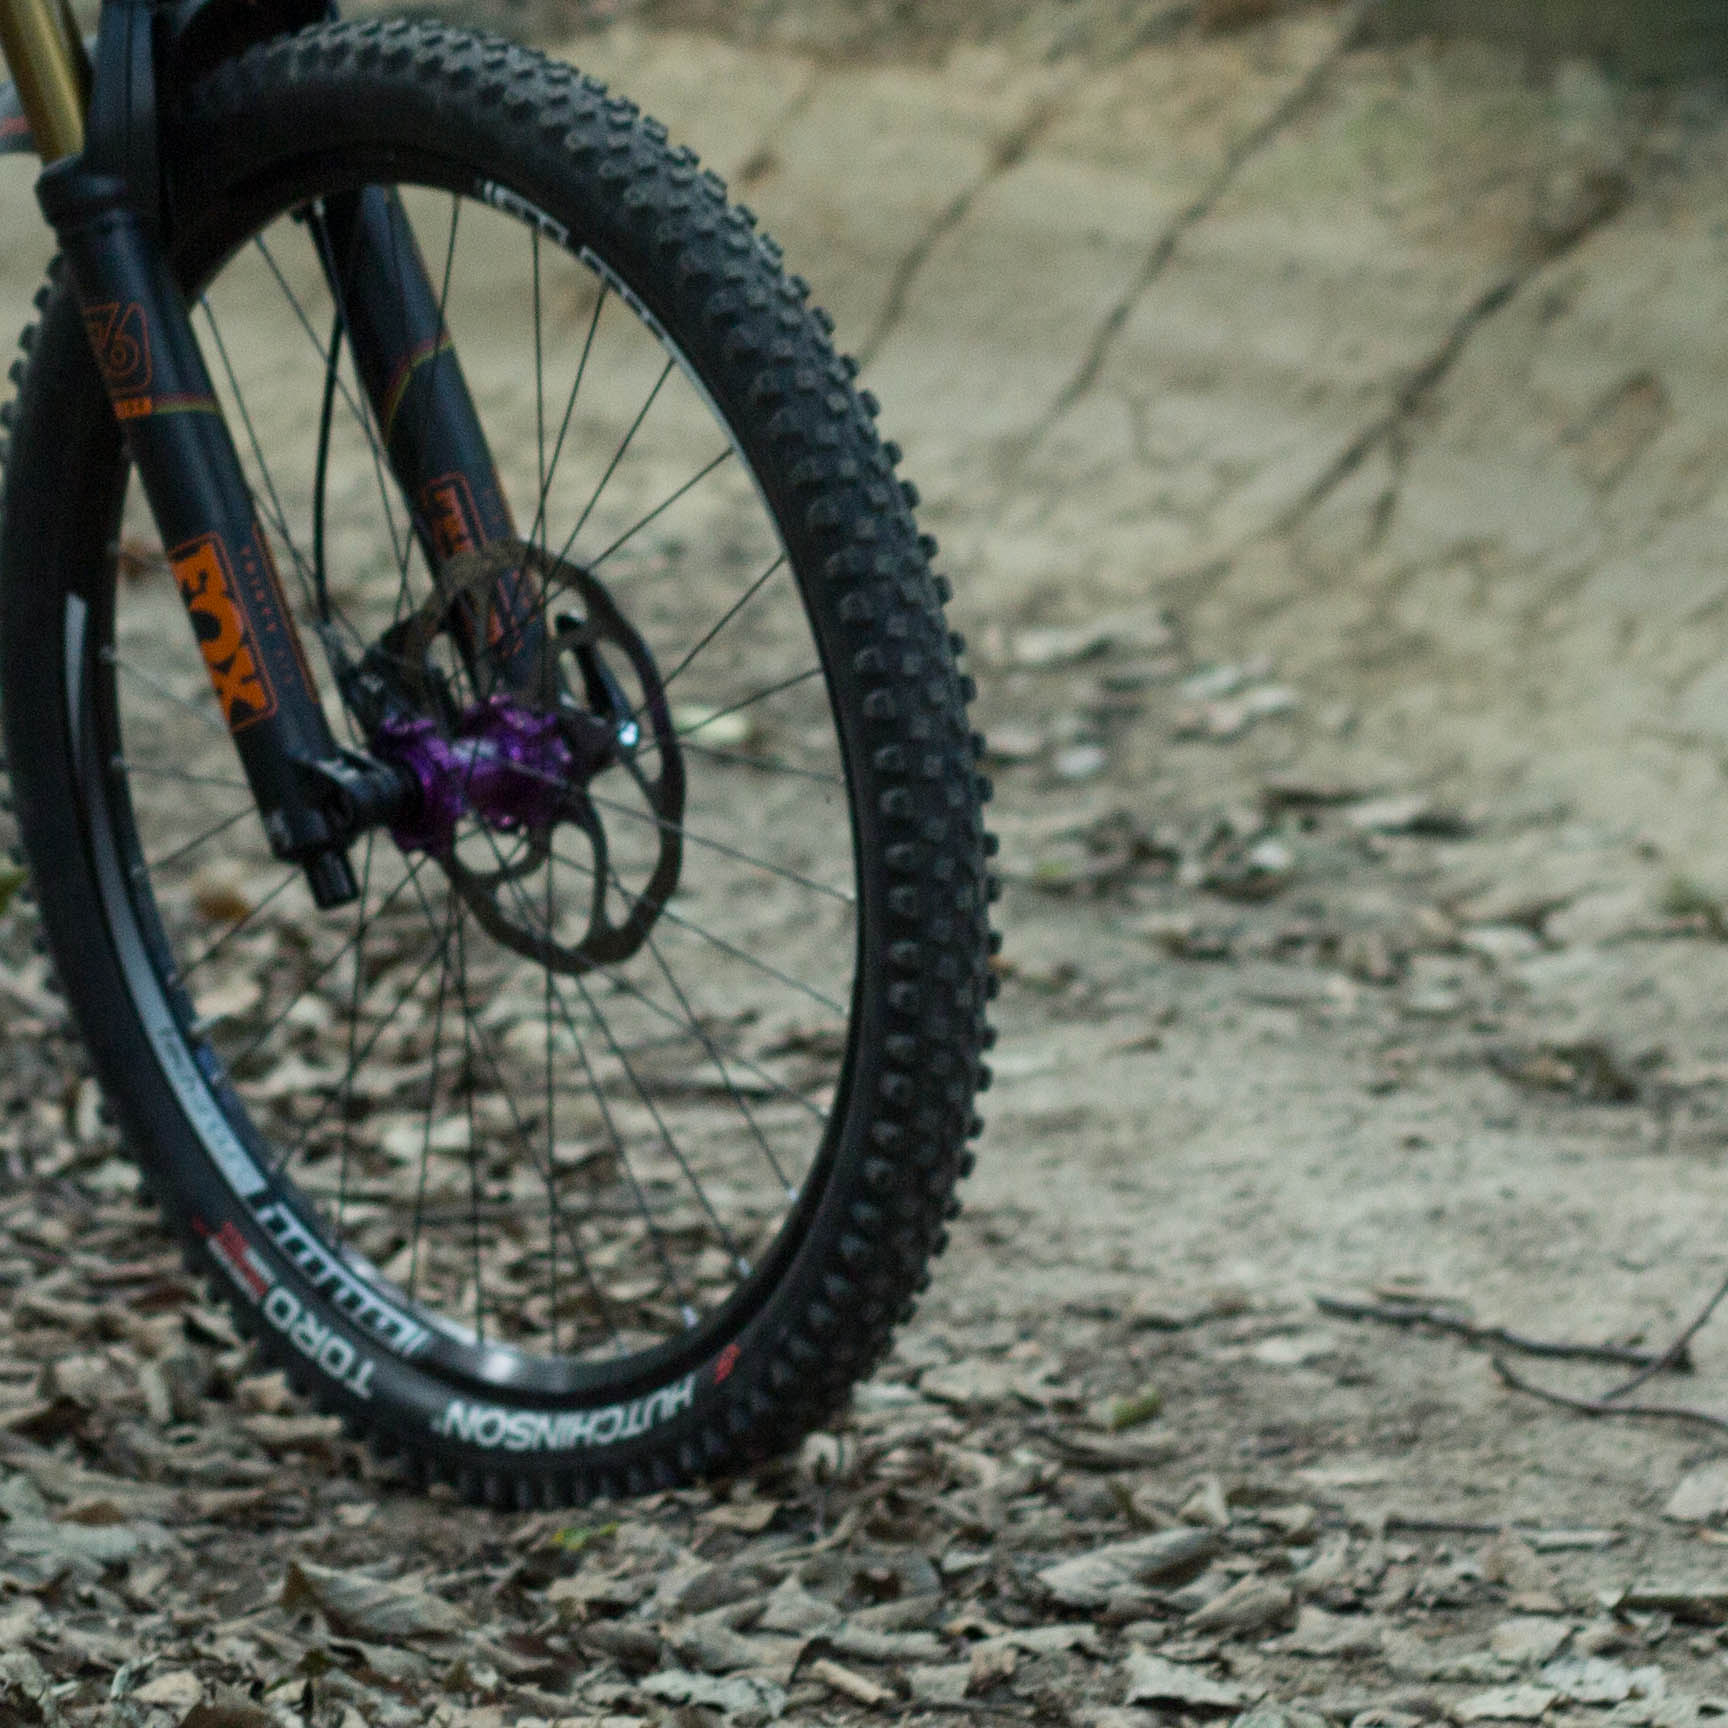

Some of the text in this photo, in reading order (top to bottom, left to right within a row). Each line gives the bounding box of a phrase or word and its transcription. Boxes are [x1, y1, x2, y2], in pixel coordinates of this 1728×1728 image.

[172, 542, 269, 722] FOX
[264, 1285, 374, 1399] TORO
[443, 1375, 696, 1450] HUTCHINSON
